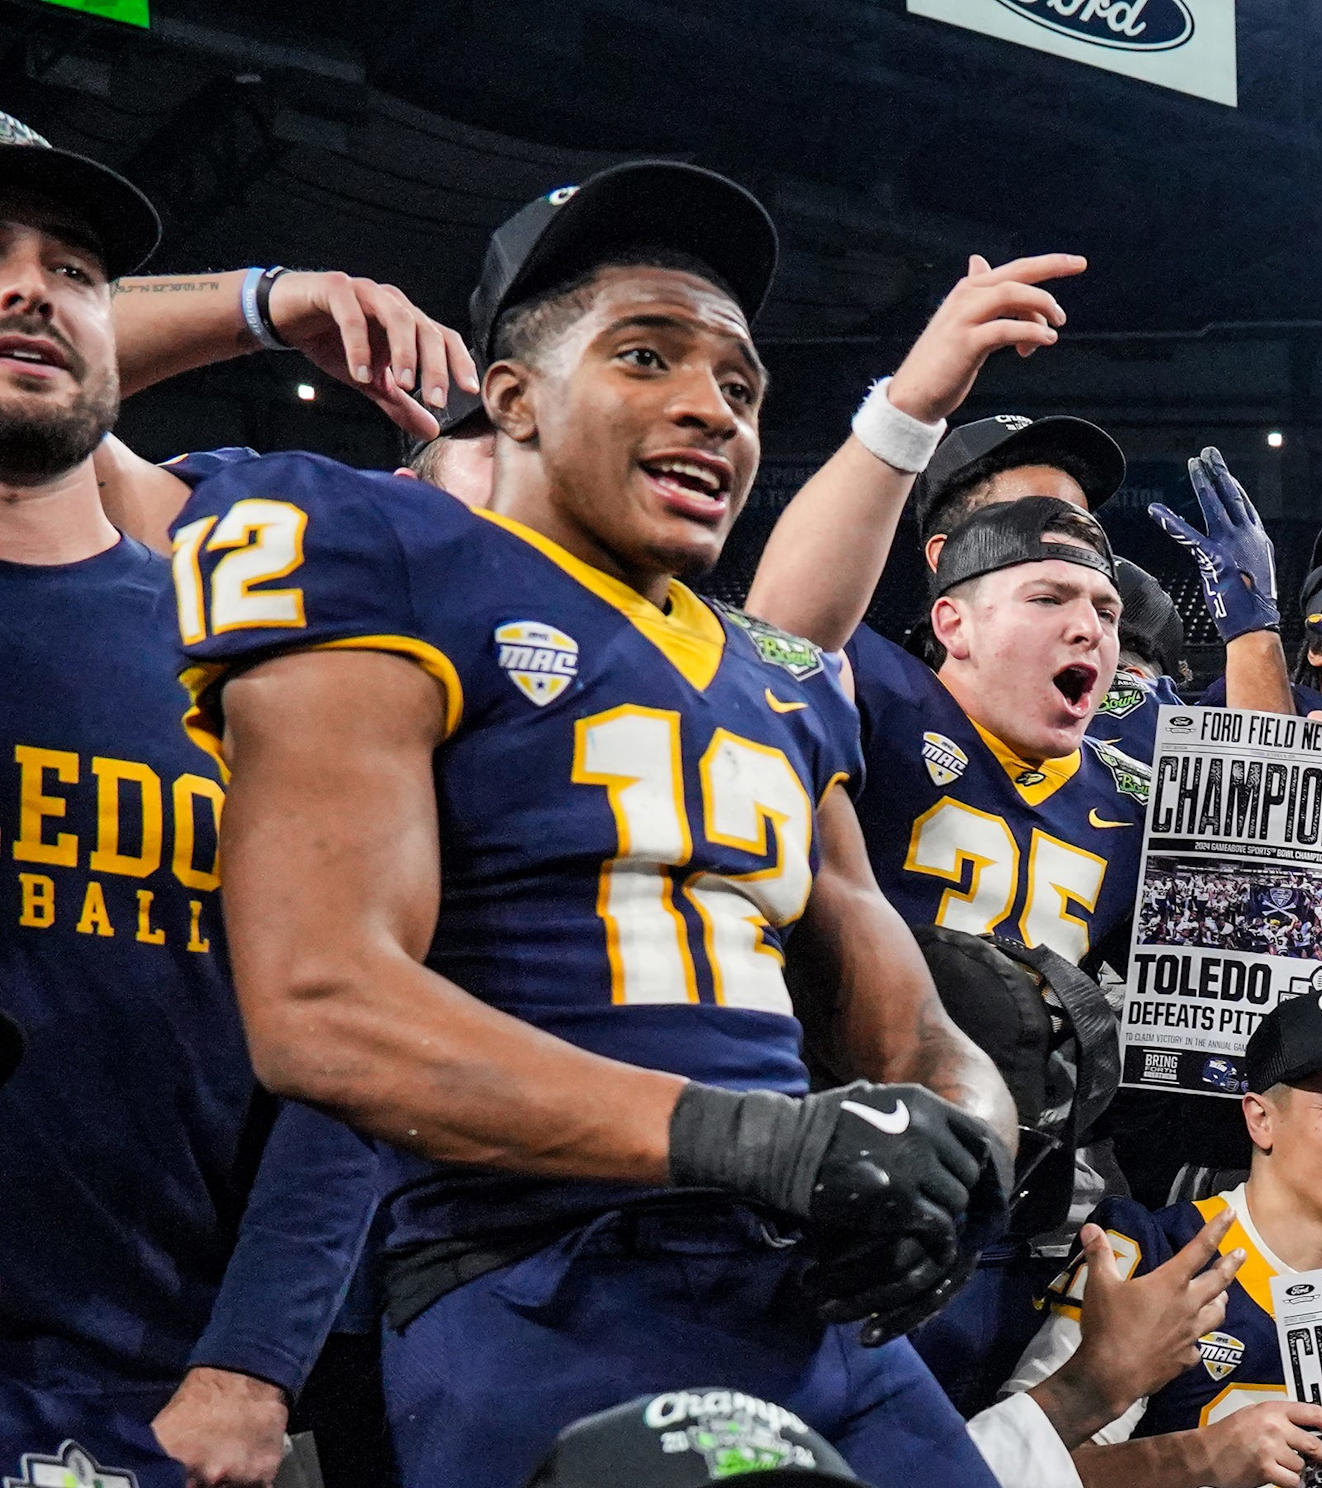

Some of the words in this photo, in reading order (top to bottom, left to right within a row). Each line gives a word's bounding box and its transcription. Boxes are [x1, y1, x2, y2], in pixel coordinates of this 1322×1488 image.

[170, 498, 308, 646] 12
[499, 644, 578, 677] MAC
[1201, 711, 1243, 744] FORD
[1248, 715, 1297, 750] FIELD
[921, 743, 968, 775] MAC
[1119, 772, 1151, 796] Bow
[13, 744, 225, 892] EDO
[572, 703, 814, 1016] 12
[1195, 840, 1210, 851] 2024
[1276, 848, 1293, 858] BOWL
[18, 873, 210, 953] BALL
[1134, 953, 1273, 1006] TOLEDO
[1128, 1001, 1215, 1031] DEFEATS
[1144, 1053, 1179, 1069] BRING
[1201, 1343, 1243, 1364] MAC
